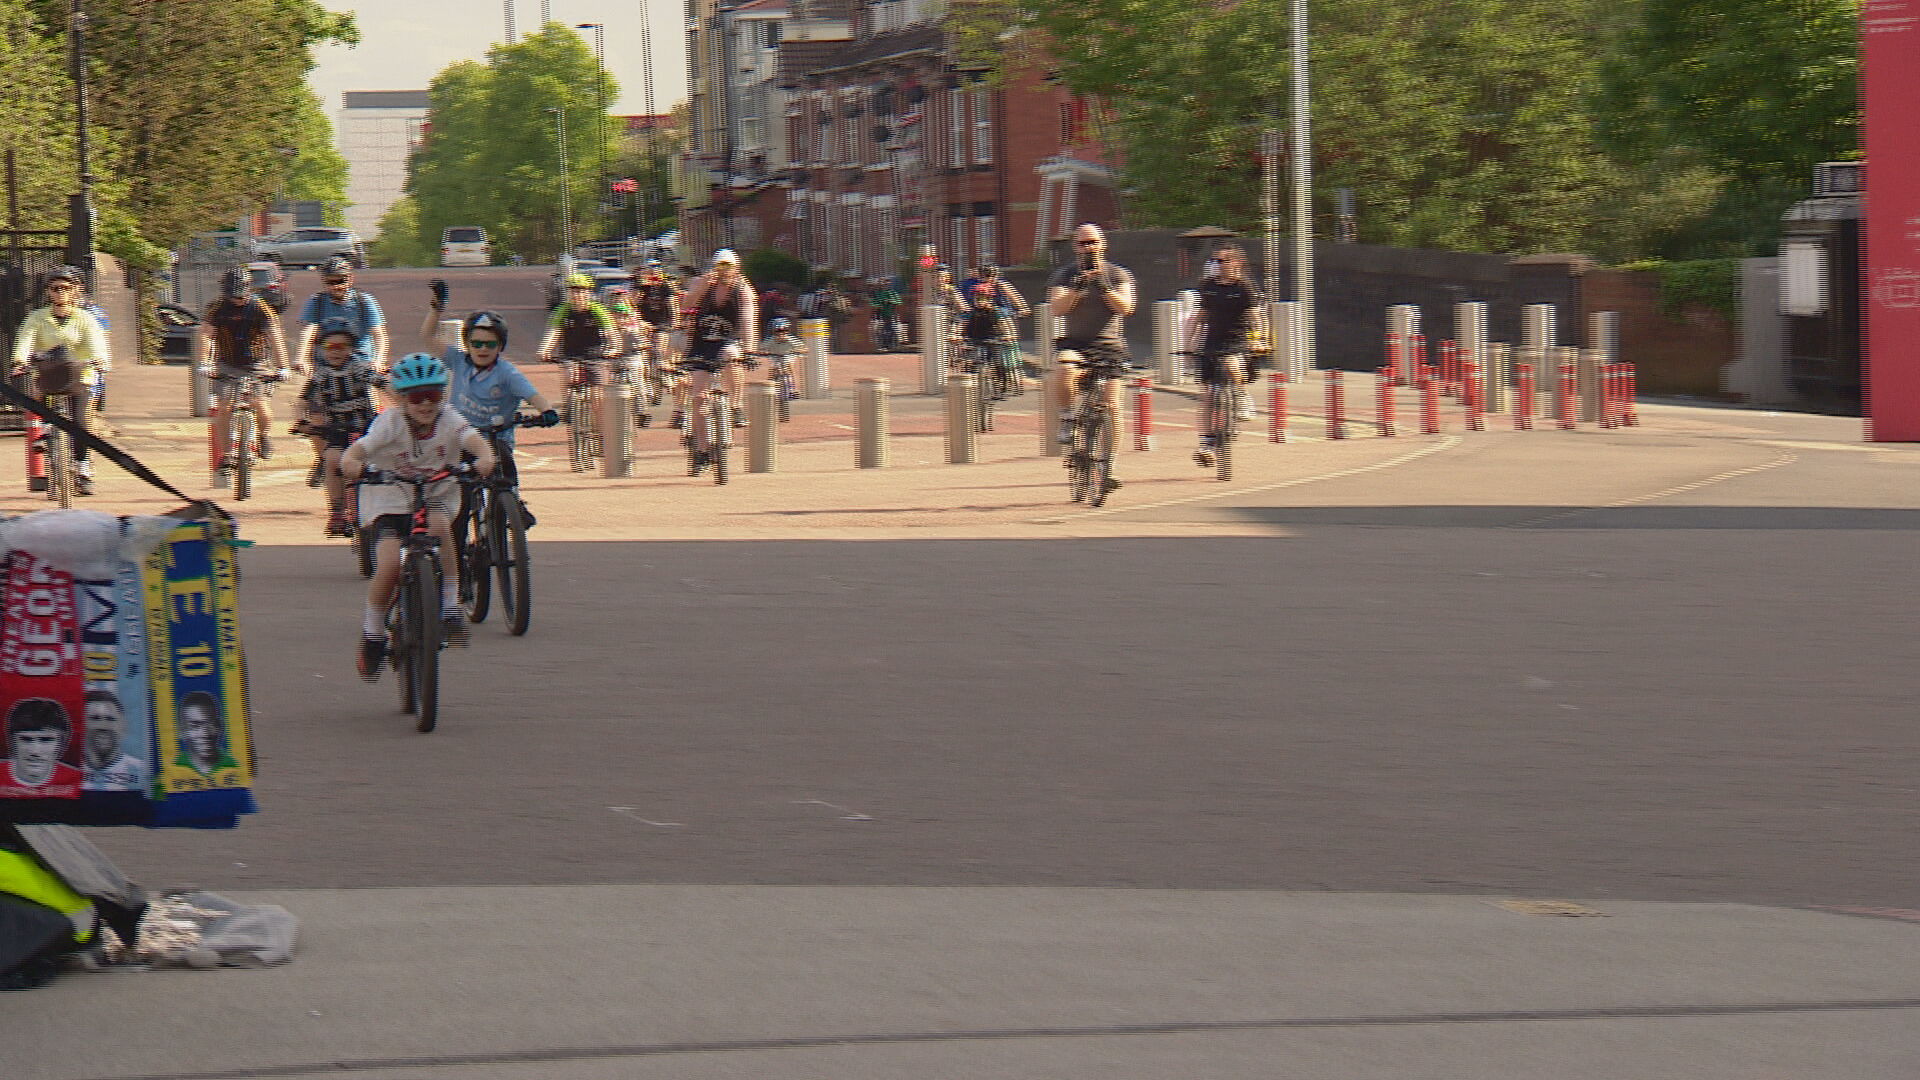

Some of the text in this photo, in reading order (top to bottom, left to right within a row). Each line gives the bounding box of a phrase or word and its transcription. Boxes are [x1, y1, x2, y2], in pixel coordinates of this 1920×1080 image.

[76, 578, 120, 682] 10 M
[215, 558, 237, 656] ALL TIME
[176, 641, 214, 678] 10
